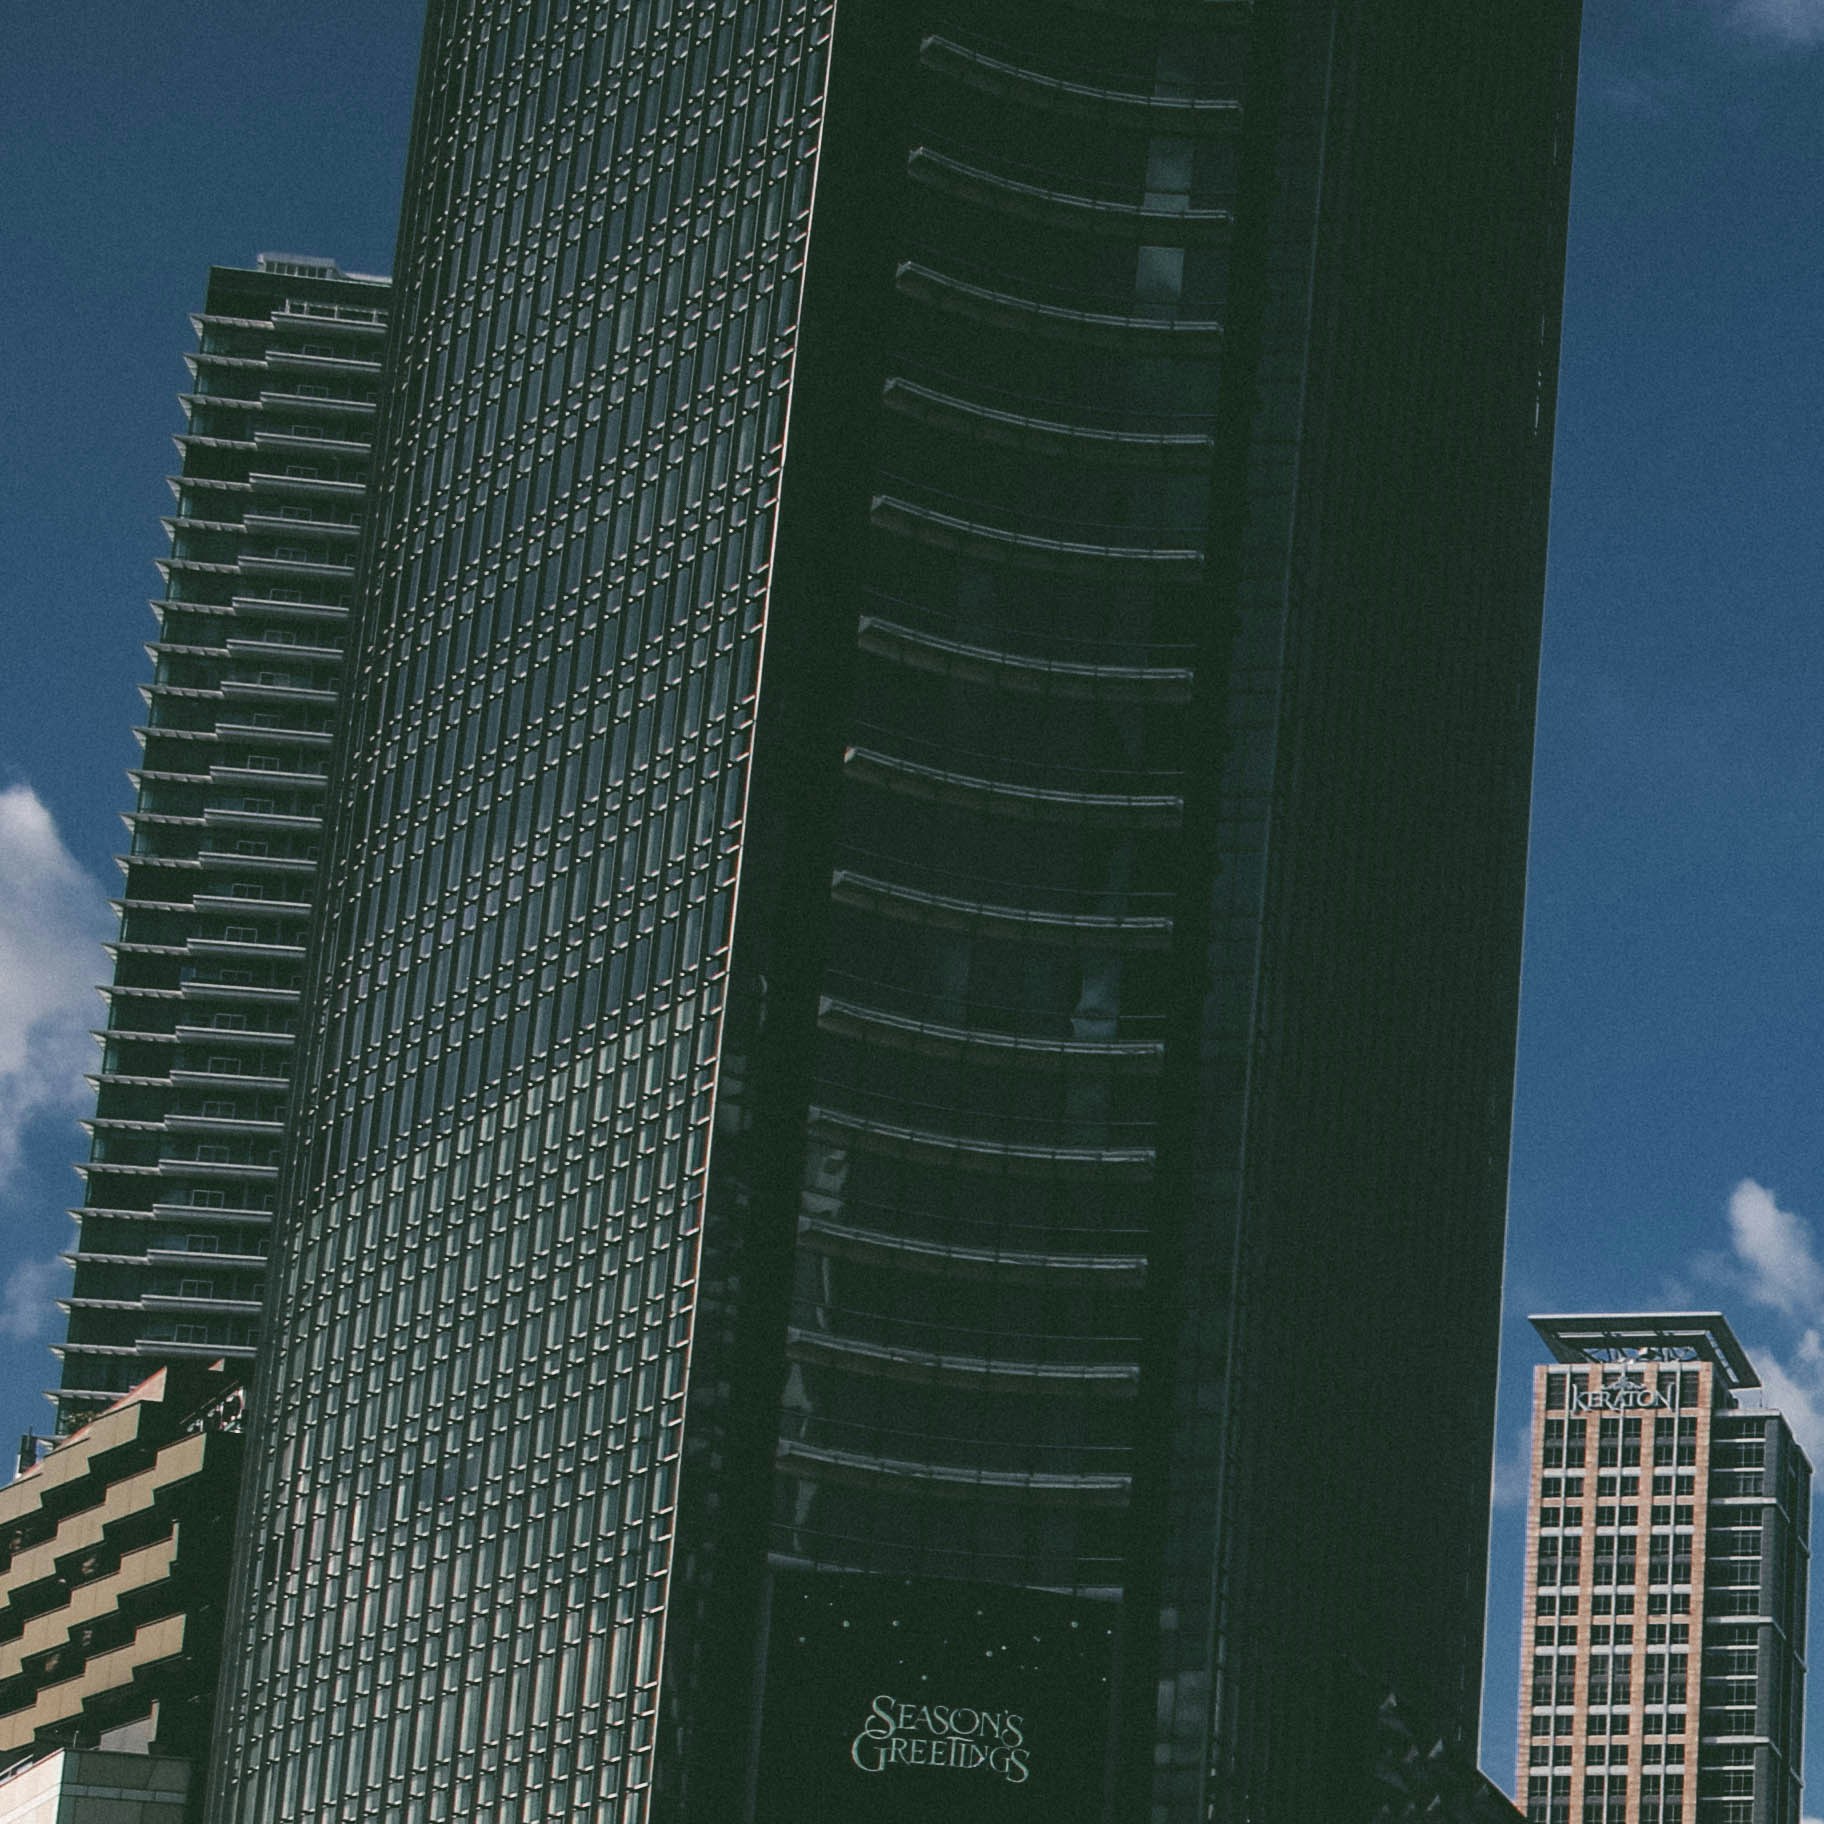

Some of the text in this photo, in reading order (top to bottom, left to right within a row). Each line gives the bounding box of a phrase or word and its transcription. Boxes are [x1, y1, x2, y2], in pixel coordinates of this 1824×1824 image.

[1571, 1382, 1677, 1412] KERATON
[864, 1695, 1024, 1748] SEASON'S
[851, 1729, 1031, 1783] GREETINGS
